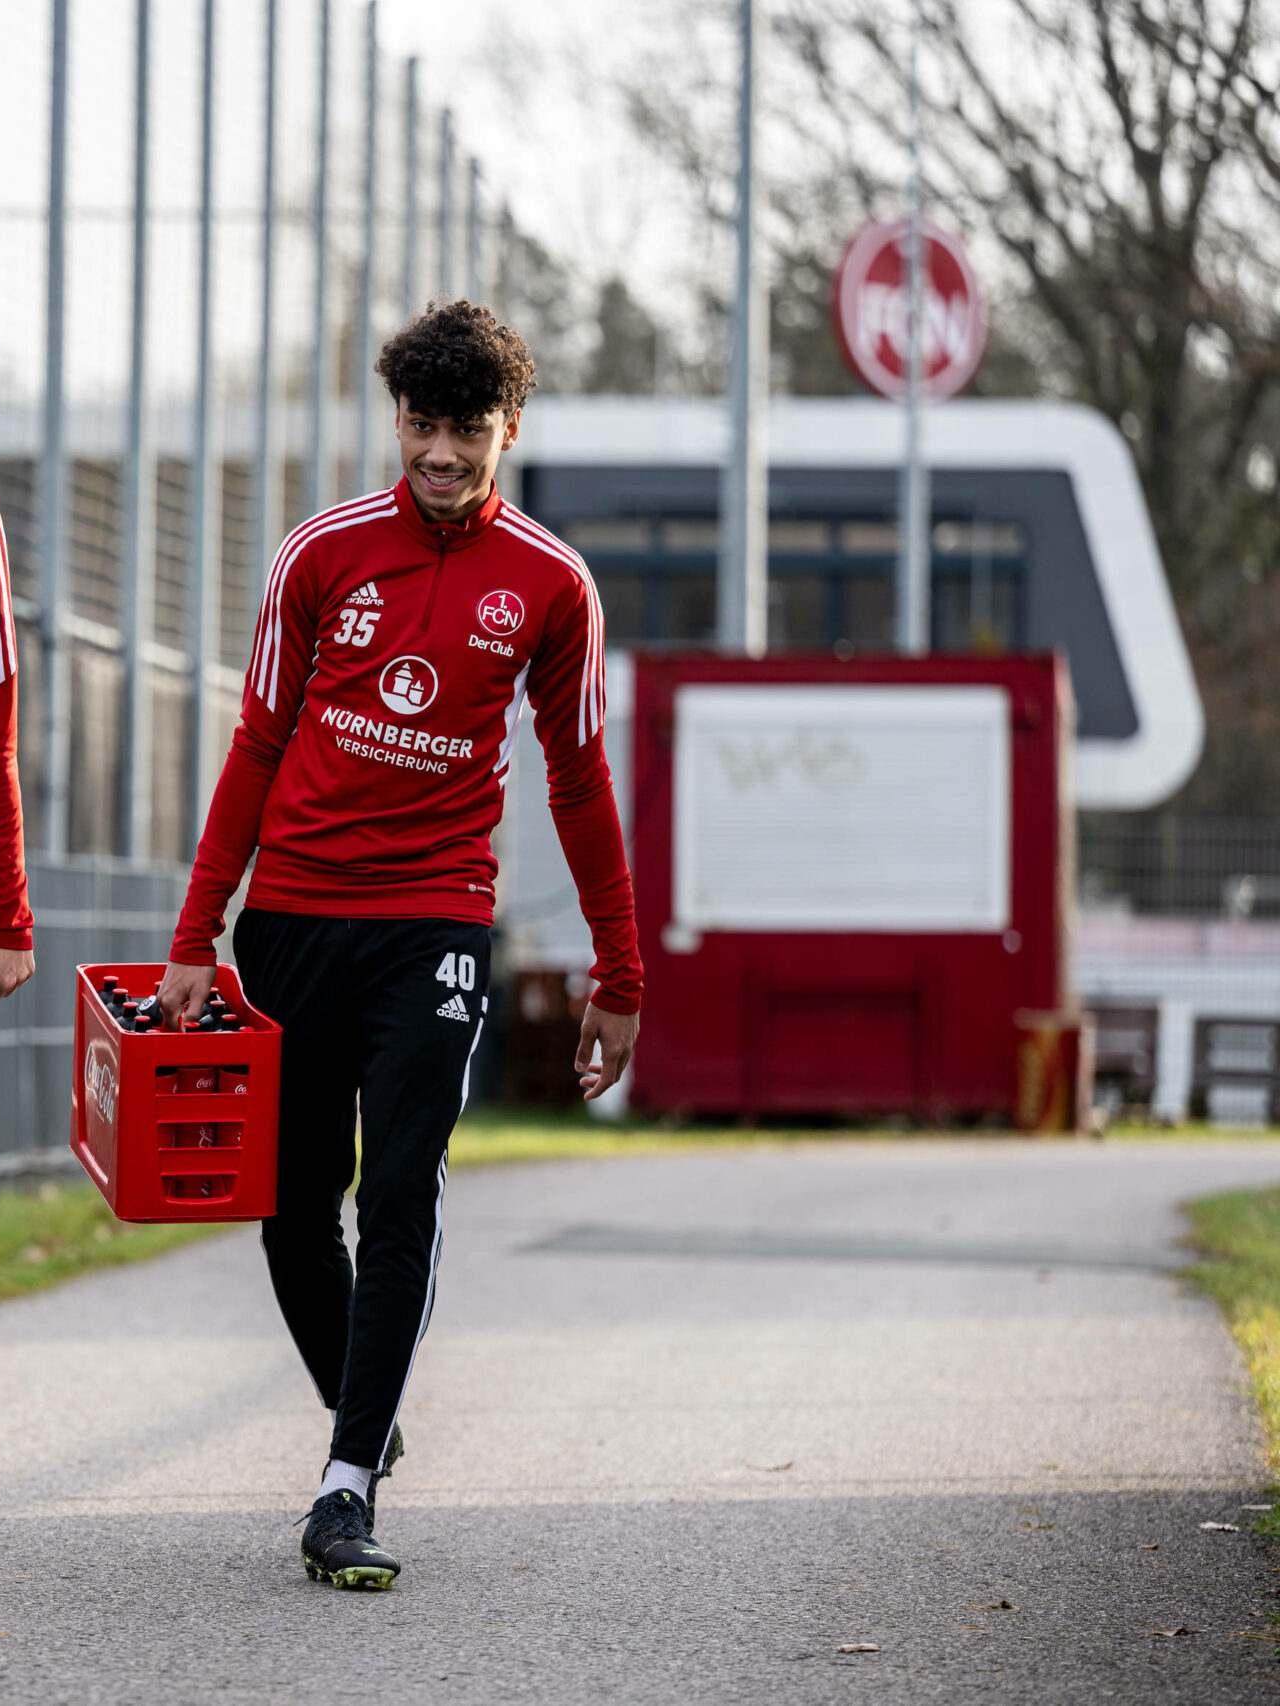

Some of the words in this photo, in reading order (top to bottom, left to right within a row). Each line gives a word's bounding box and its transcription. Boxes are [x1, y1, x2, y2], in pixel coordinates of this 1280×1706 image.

[345, 596, 385, 606] adidas
[498, 594, 508, 609] 1.
[333, 608, 382, 648] 35
[482, 605, 519, 628] FCN
[468, 634, 490, 650] Der
[489, 639, 515, 657] Club
[320, 705, 473, 759] NÜRNBERGER
[335, 735, 449, 775] VERSICHERUNG
[435, 952, 475, 992] 40
[436, 1007, 470, 1023] adidas
